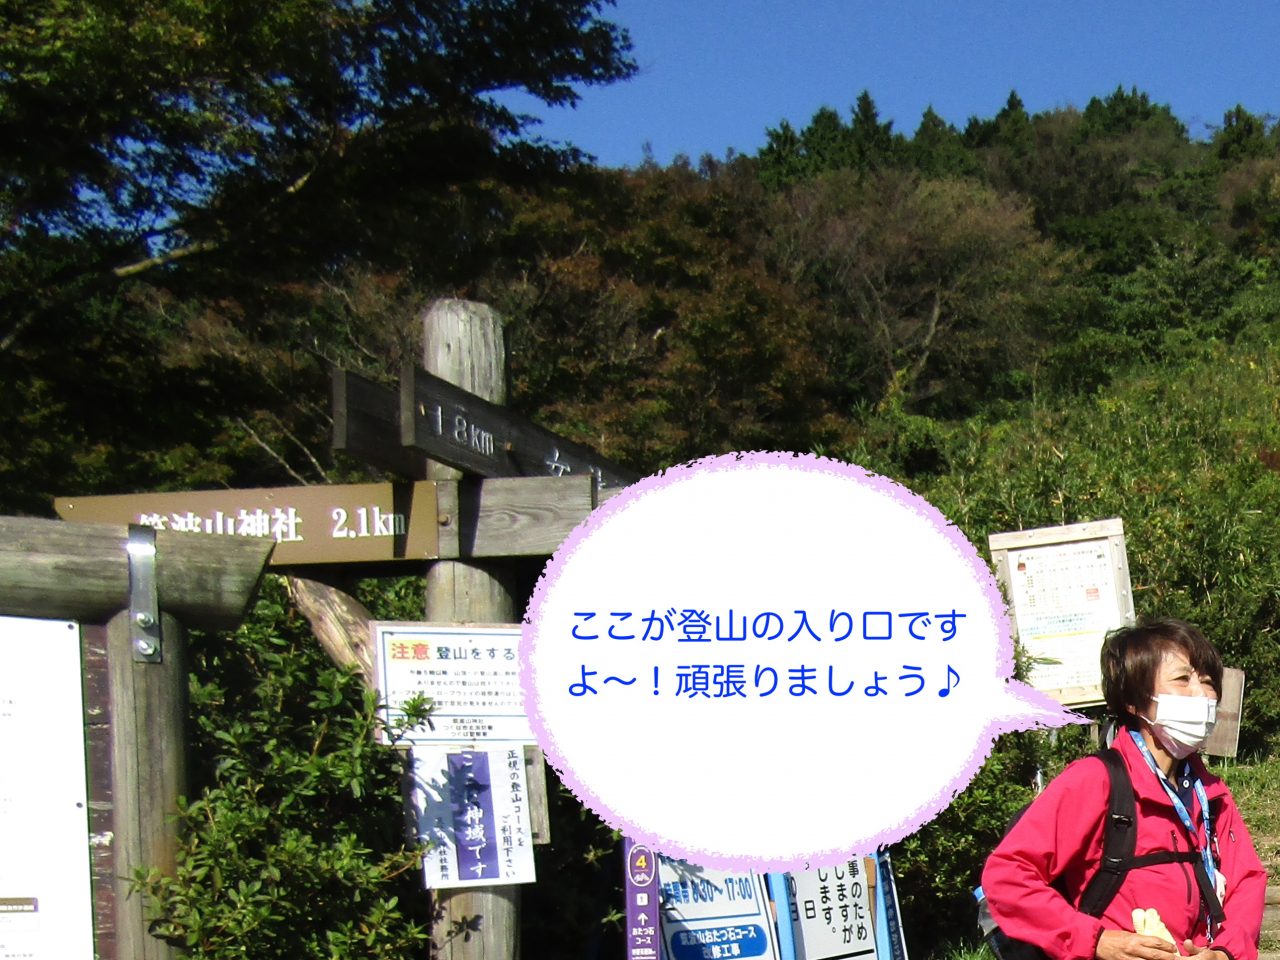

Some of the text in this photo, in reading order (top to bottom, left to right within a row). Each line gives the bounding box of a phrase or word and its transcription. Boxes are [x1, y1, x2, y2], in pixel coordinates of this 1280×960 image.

[331, 505, 406, 539] 2.1km
[391, 642, 431, 661] 注意
[635, 855, 648, 869] 4
[632, 926, 655, 936] おたつ石
[680, 926, 757, 946] 筑波山おたつ石コース
[635, 936, 652, 945] コース
[702, 943, 741, 959] 改修工事
